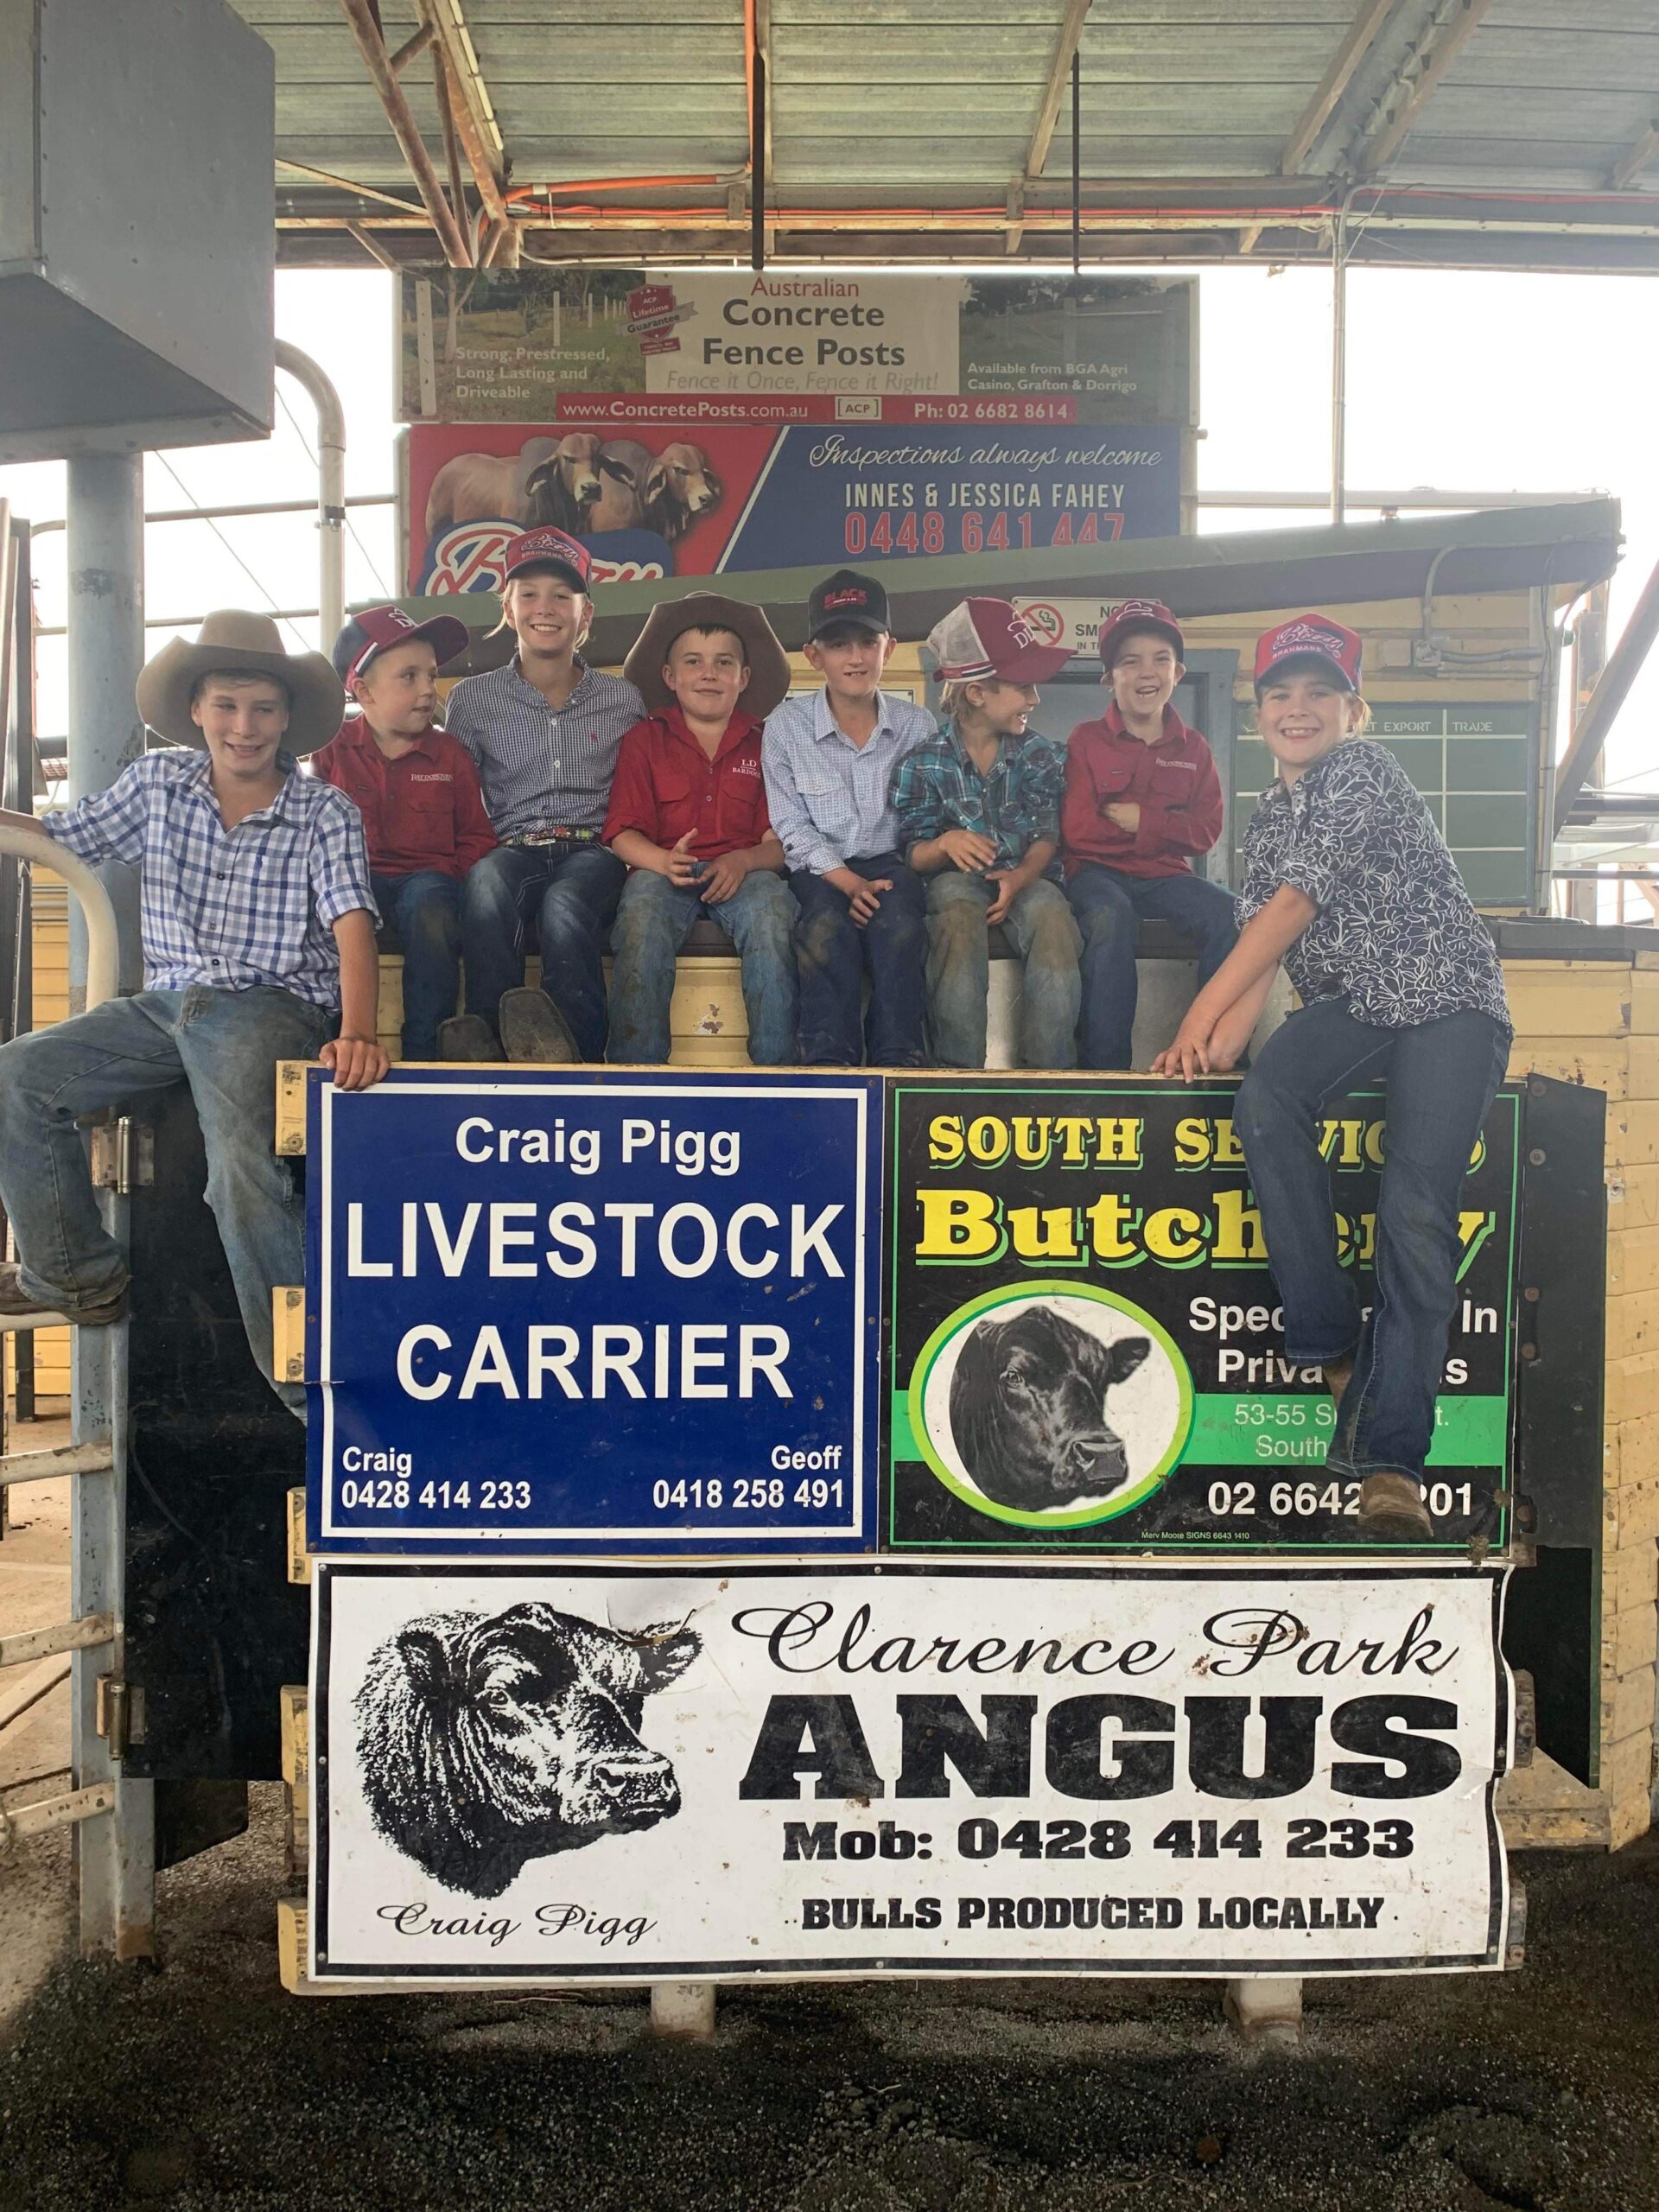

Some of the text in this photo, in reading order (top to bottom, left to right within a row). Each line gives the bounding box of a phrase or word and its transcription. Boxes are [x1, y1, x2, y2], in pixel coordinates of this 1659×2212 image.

[751, 276, 860, 297] Australian
[626, 314, 681, 334] Guarantee
[632, 304, 670, 319] Lifetime
[722, 299, 885, 327] Concrete
[456, 346, 611, 364] Strong, Prestressed,
[702, 337, 804, 365] Fence
[817, 338, 906, 366] Posts
[456, 366, 588, 384] Long Lasting and
[667, 371, 938, 394] Fence it Once, Fence it Right!
[968, 363, 1128, 378] Available from BGA Agri
[456, 385, 531, 398] Driveable
[968, 378, 1137, 394] Casino, Grafton & Dorrigo
[563, 400, 808, 418] www.ConcretePosts.com.au
[913, 403, 1068, 419] Ph: 02 6682 8614
[810, 435, 1163, 473] Inspections always welcome
[845, 482, 1125, 508] INNES & JESSICA FAHEY
[844, 512, 1126, 554] 0448 641 447
[1077, 641, 1087, 651] IN
[1272, 645, 1323, 660] BRAHMANS
[1384, 721, 1432, 733] EXPORT
[1452, 721, 1493, 732] TRADE
[456, 1117, 741, 1176] Craig Pigg
[929, 1116, 1142, 1170] SOUTH
[348, 1202, 846, 1278] LIVESTOCK
[1462, 1300, 1497, 1333] In
[397, 1324, 794, 1401] CARRIER
[1235, 1403, 1306, 1426] 53-55
[771, 1445, 842, 1471] Geoff
[1255, 1434, 1328, 1458] South
[342, 1446, 412, 1478] Craig
[341, 1479, 531, 1510] 0428 414 233
[653, 1478, 843, 1509] 0418 258 491
[1208, 1481, 1255, 1516] 02
[1269, 1482, 1362, 1516] 6642
[1186, 1531, 1211, 1540] SIGNS
[732, 1601, 1459, 1675] Clarence Park
[739, 1694, 1462, 1800] ANGUS
[783, 1818, 1414, 1860] Mob: 0428 414 233
[376, 1903, 658, 1948] Craig Pigg
[802, 1897, 1384, 1930] BULLS PRODUCED LOCALLY
